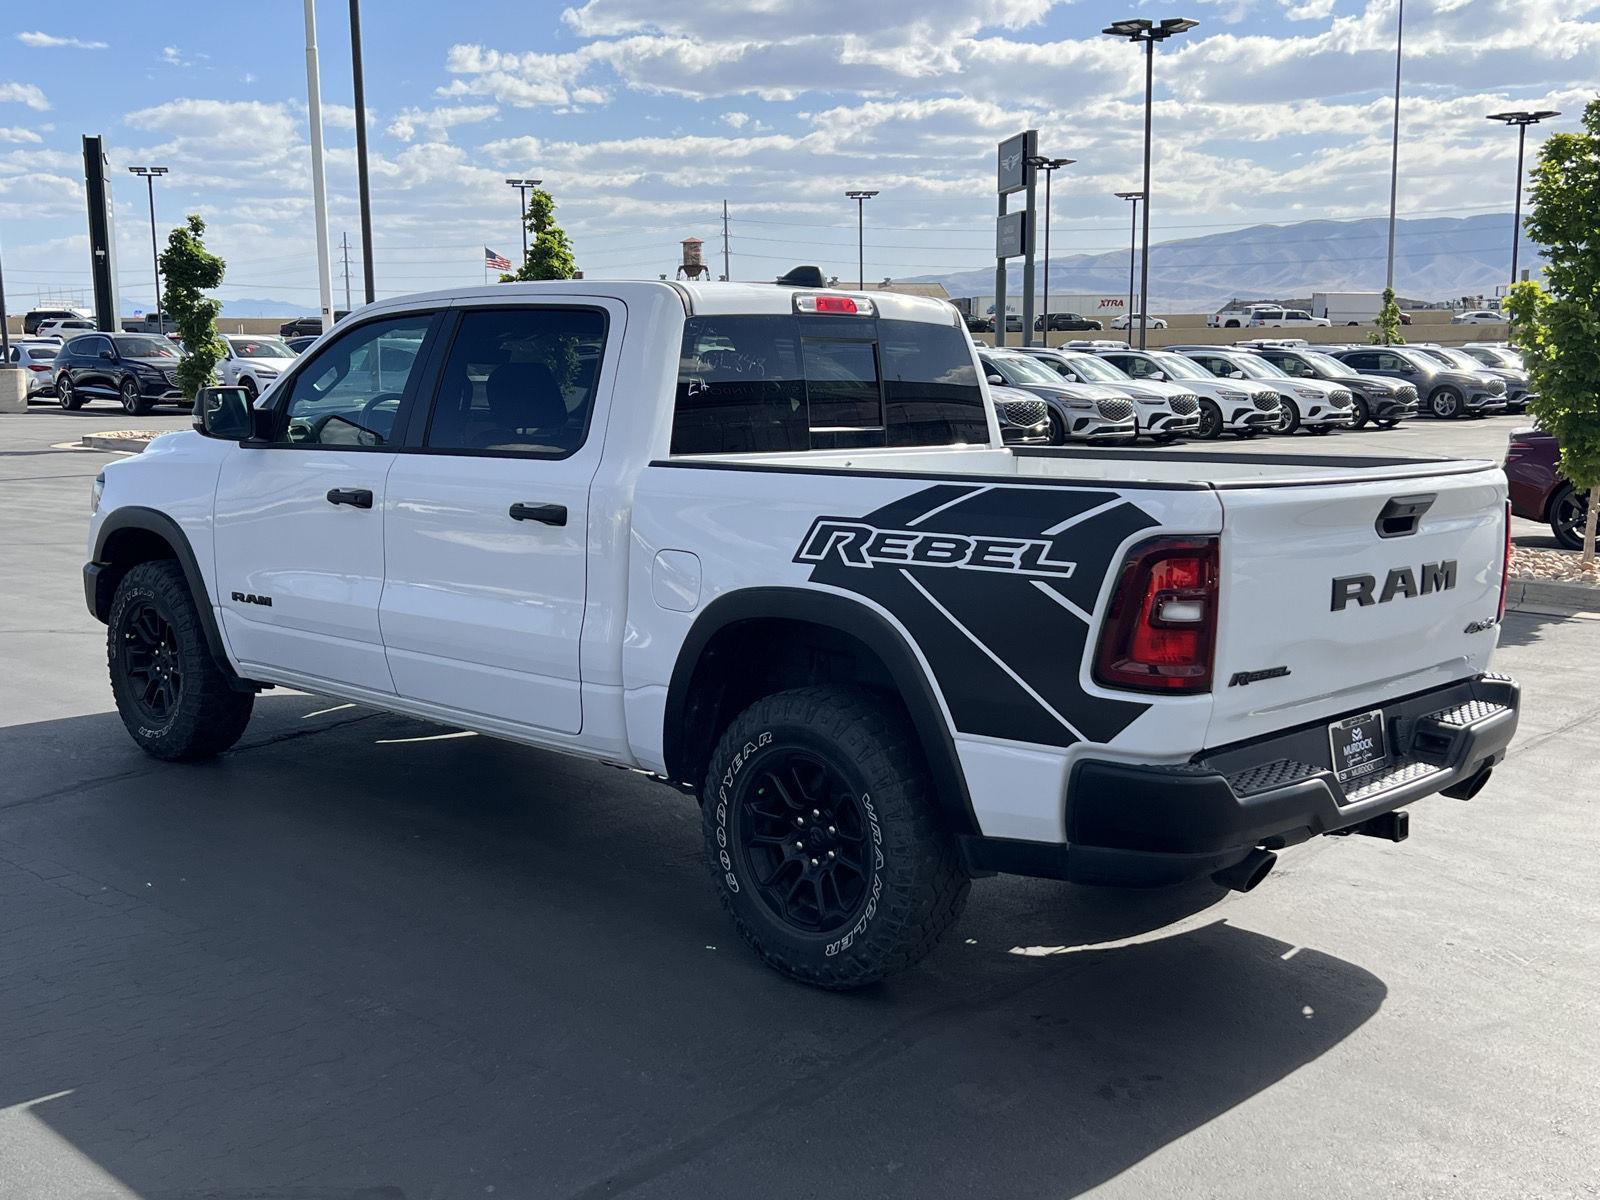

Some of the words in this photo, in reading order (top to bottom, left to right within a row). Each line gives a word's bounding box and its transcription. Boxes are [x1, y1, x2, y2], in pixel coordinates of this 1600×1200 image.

[1098, 299, 1124, 309] XTRA
[797, 518, 1078, 579] REBEL
[231, 591, 273, 607] RAM
[1330, 559, 1458, 612] RAM
[1228, 665, 1292, 688] REBEL
[1343, 737, 1374, 756] MURDOCK
[716, 731, 772, 894] GOODYEAR
[825, 792, 884, 957] WRANGLER
